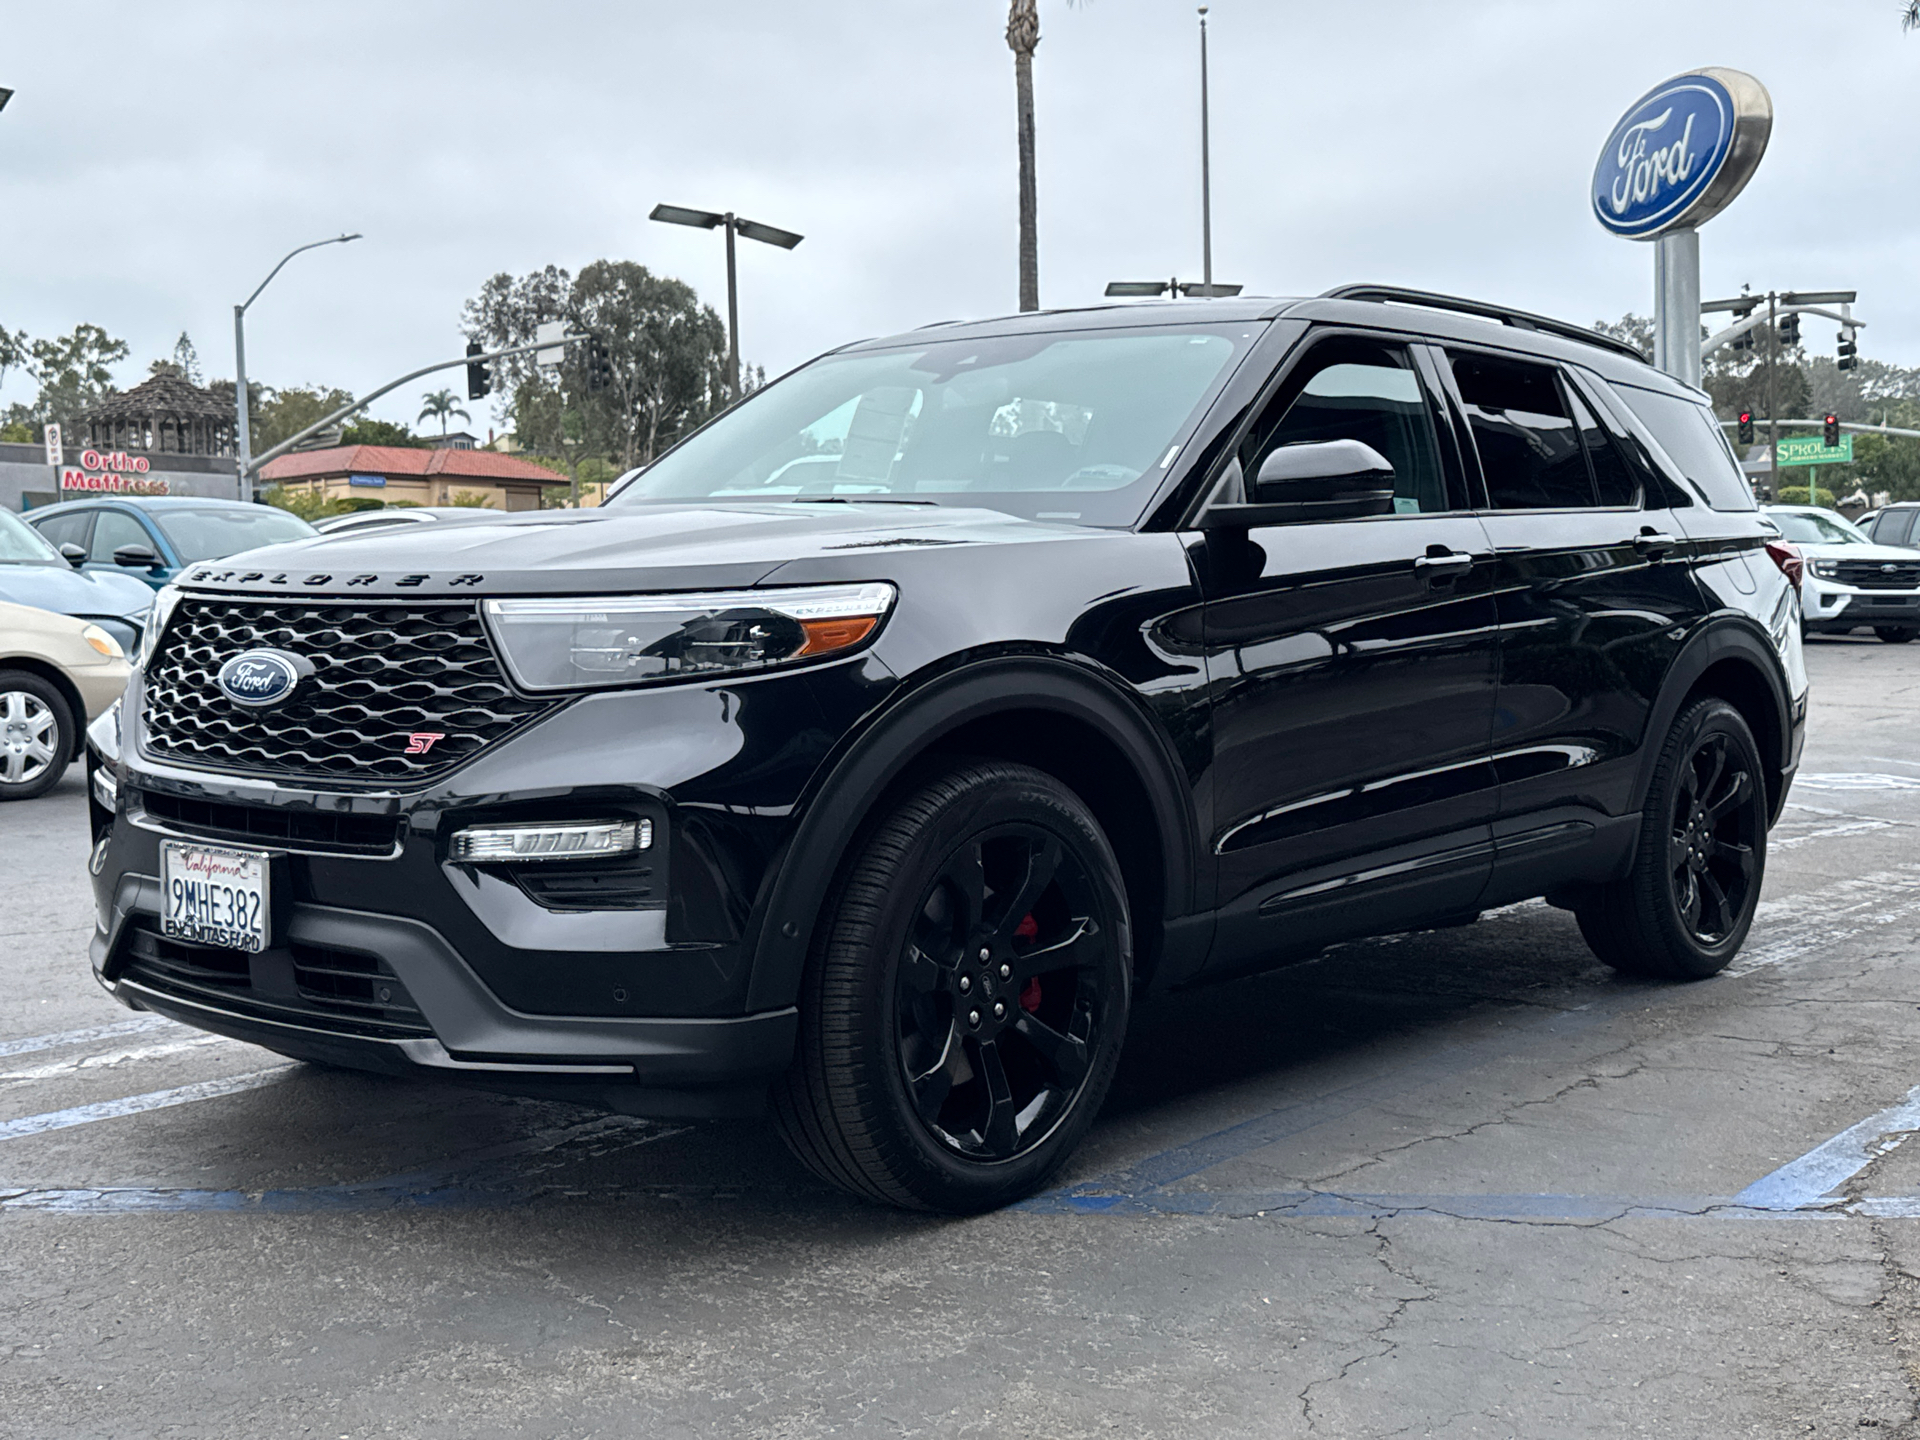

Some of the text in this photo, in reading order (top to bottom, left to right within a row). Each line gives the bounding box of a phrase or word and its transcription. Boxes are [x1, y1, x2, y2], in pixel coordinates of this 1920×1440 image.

[1612, 107, 1696, 214] Ford
[81, 449, 150, 473] Ortho
[62, 471, 170, 496] Mattress
[191, 570, 484, 587] EXPLORER
[231, 662, 276, 692] Ford
[404, 732, 446, 754] ST
[185, 852, 248, 880] California
[173, 878, 262, 933] 9MHE382
